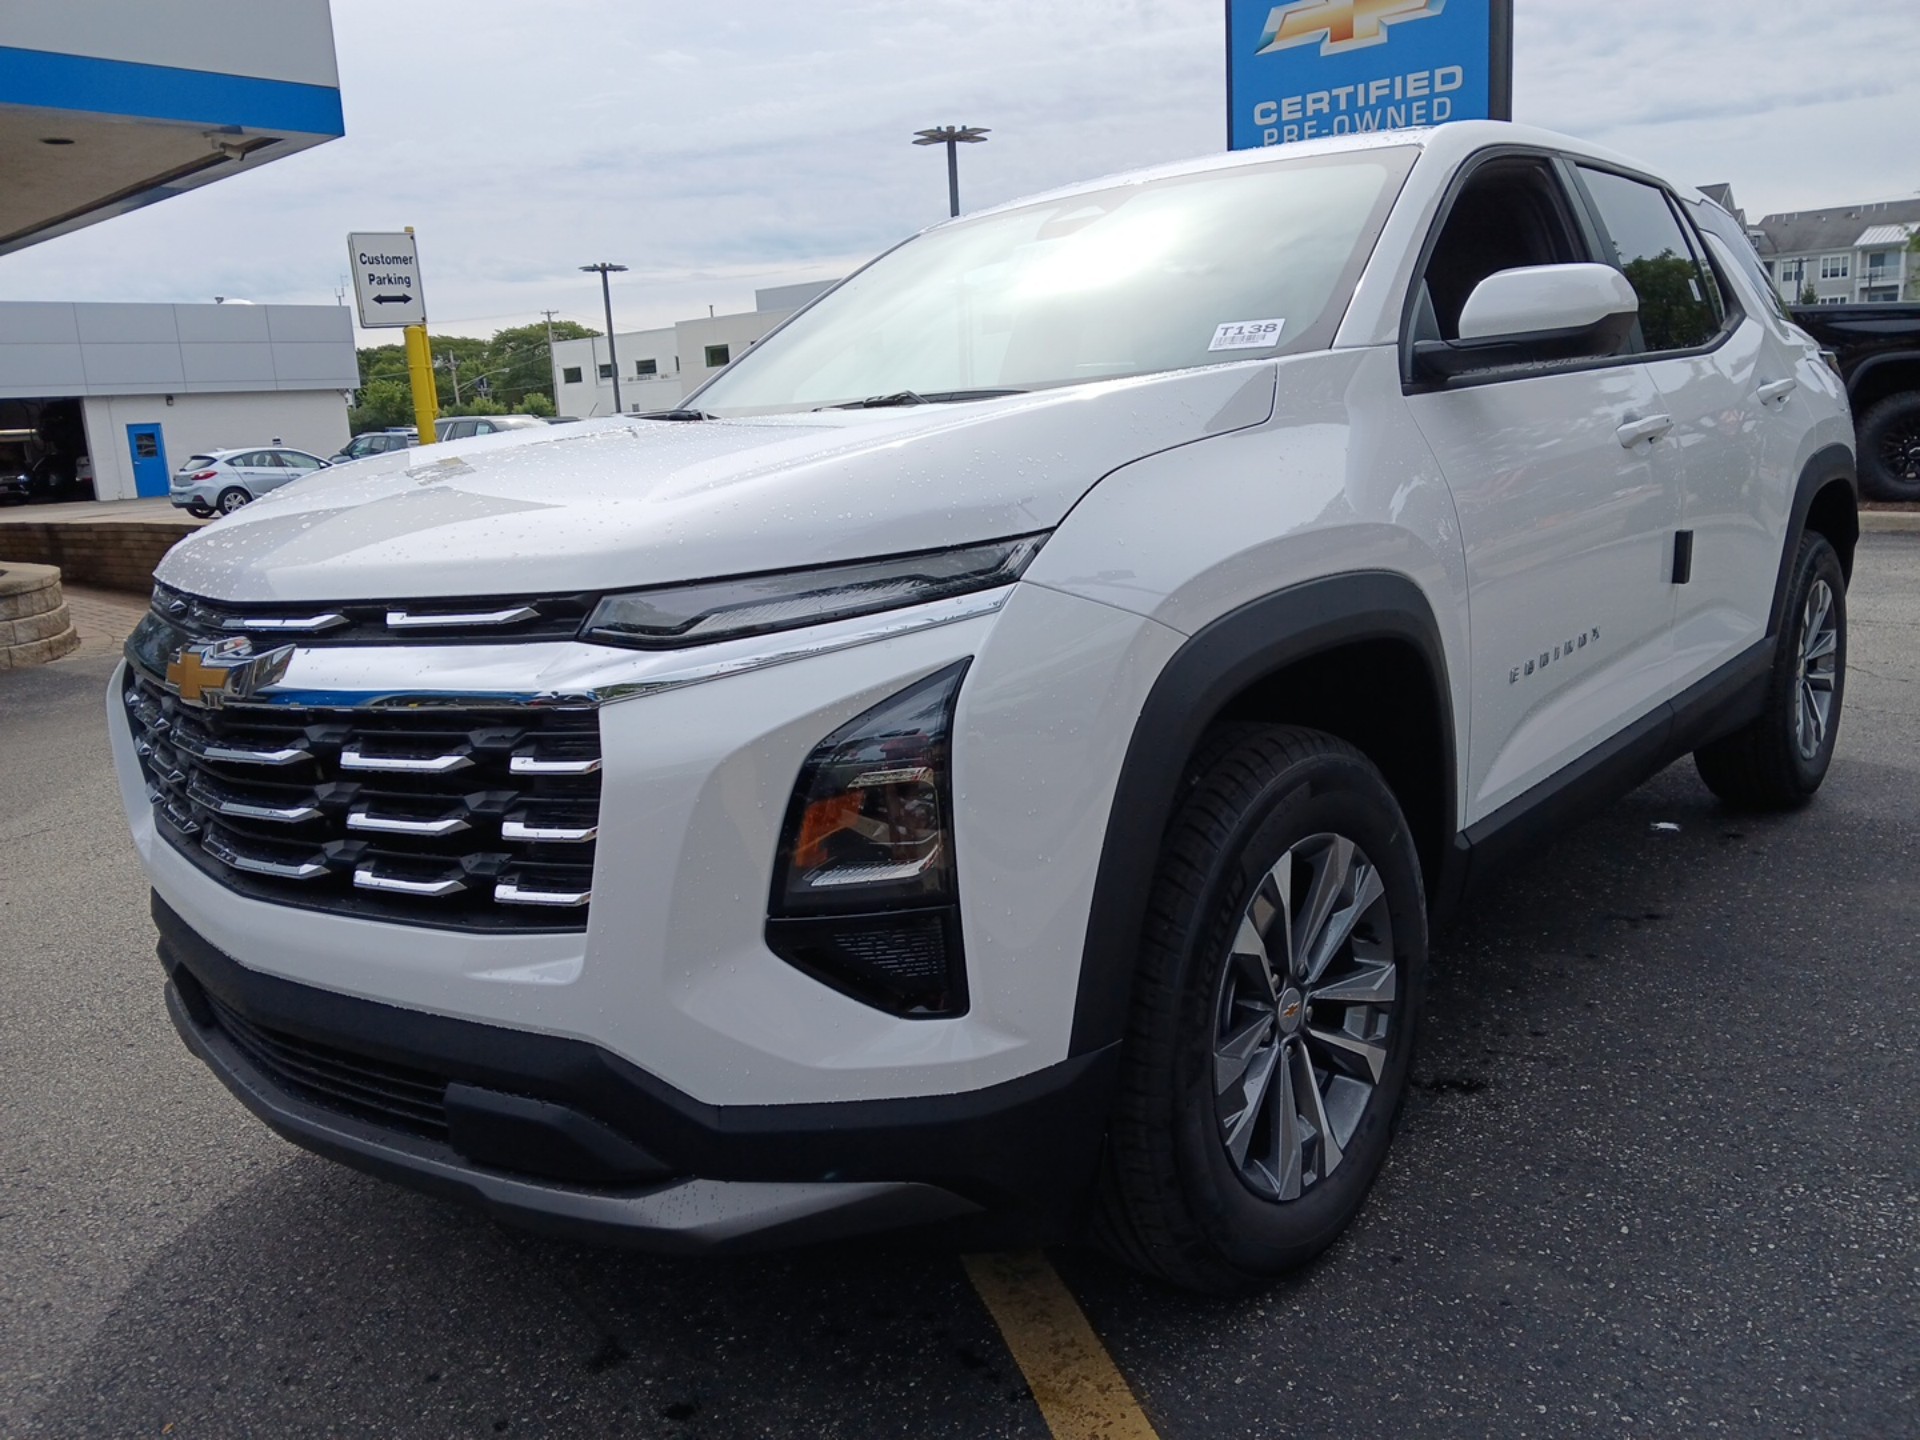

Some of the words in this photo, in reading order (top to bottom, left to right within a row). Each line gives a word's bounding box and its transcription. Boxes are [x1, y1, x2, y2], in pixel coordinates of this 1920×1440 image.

[1254, 65, 1463, 125] CERTIFIED
[1263, 97, 1452, 146] PRE-OWNED
[360, 252, 413, 265] Customer
[368, 273, 412, 288] Parking
[1220, 323, 1278, 337] T138
[1508, 626, 1601, 685] EQUINOX
